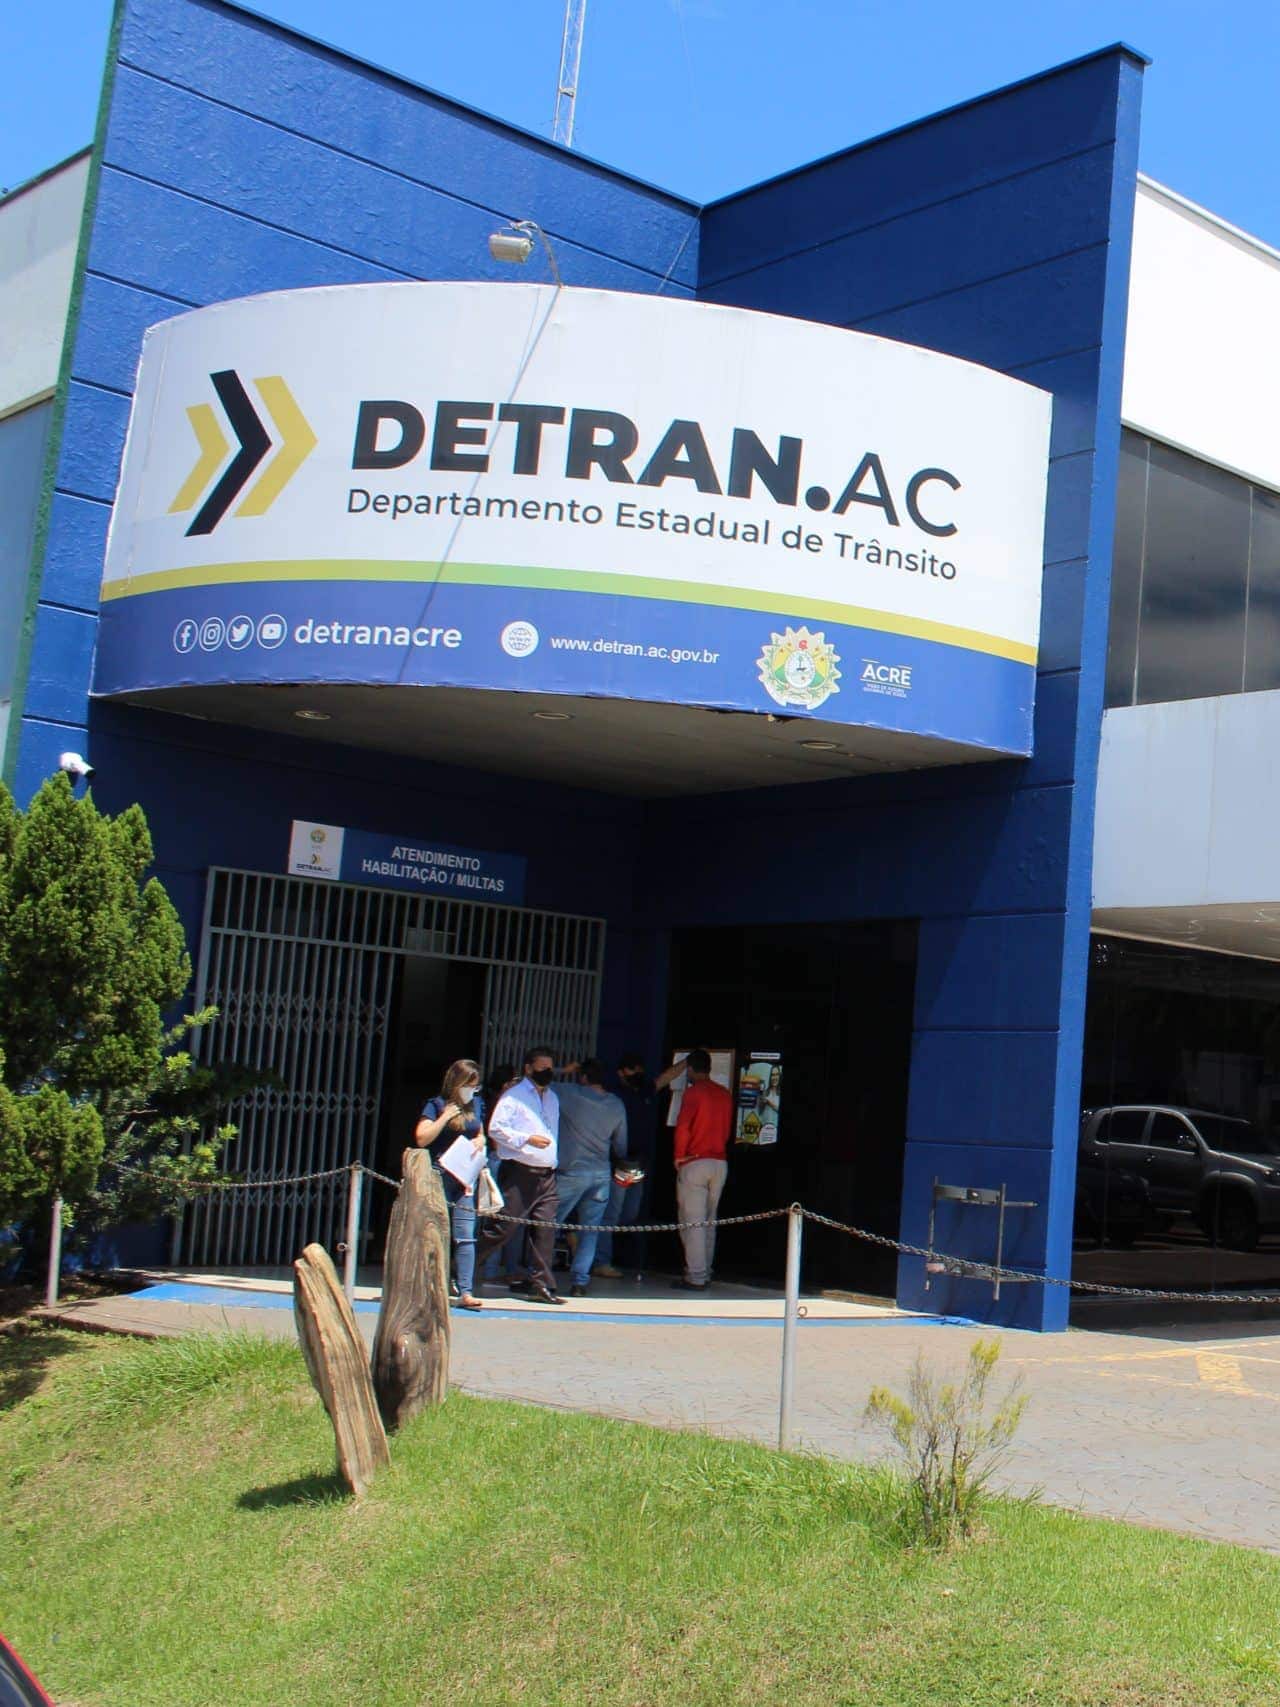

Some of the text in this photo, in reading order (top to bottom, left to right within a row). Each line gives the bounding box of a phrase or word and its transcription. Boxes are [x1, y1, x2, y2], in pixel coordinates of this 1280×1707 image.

[352, 400, 962, 538] DETRAN.AC
[347, 489, 956, 580] Departamento Estadual de Trânsito
[294, 618, 463, 648] detranacre
[551, 636, 721, 664] www.detran.ac.gov.br
[862, 664, 911, 686] ACRE
[391, 846, 481, 872] ATENDIMENTO
[361, 859, 448, 884] HABILITAÇÃO
[456, 873, 505, 892] MULTAS
